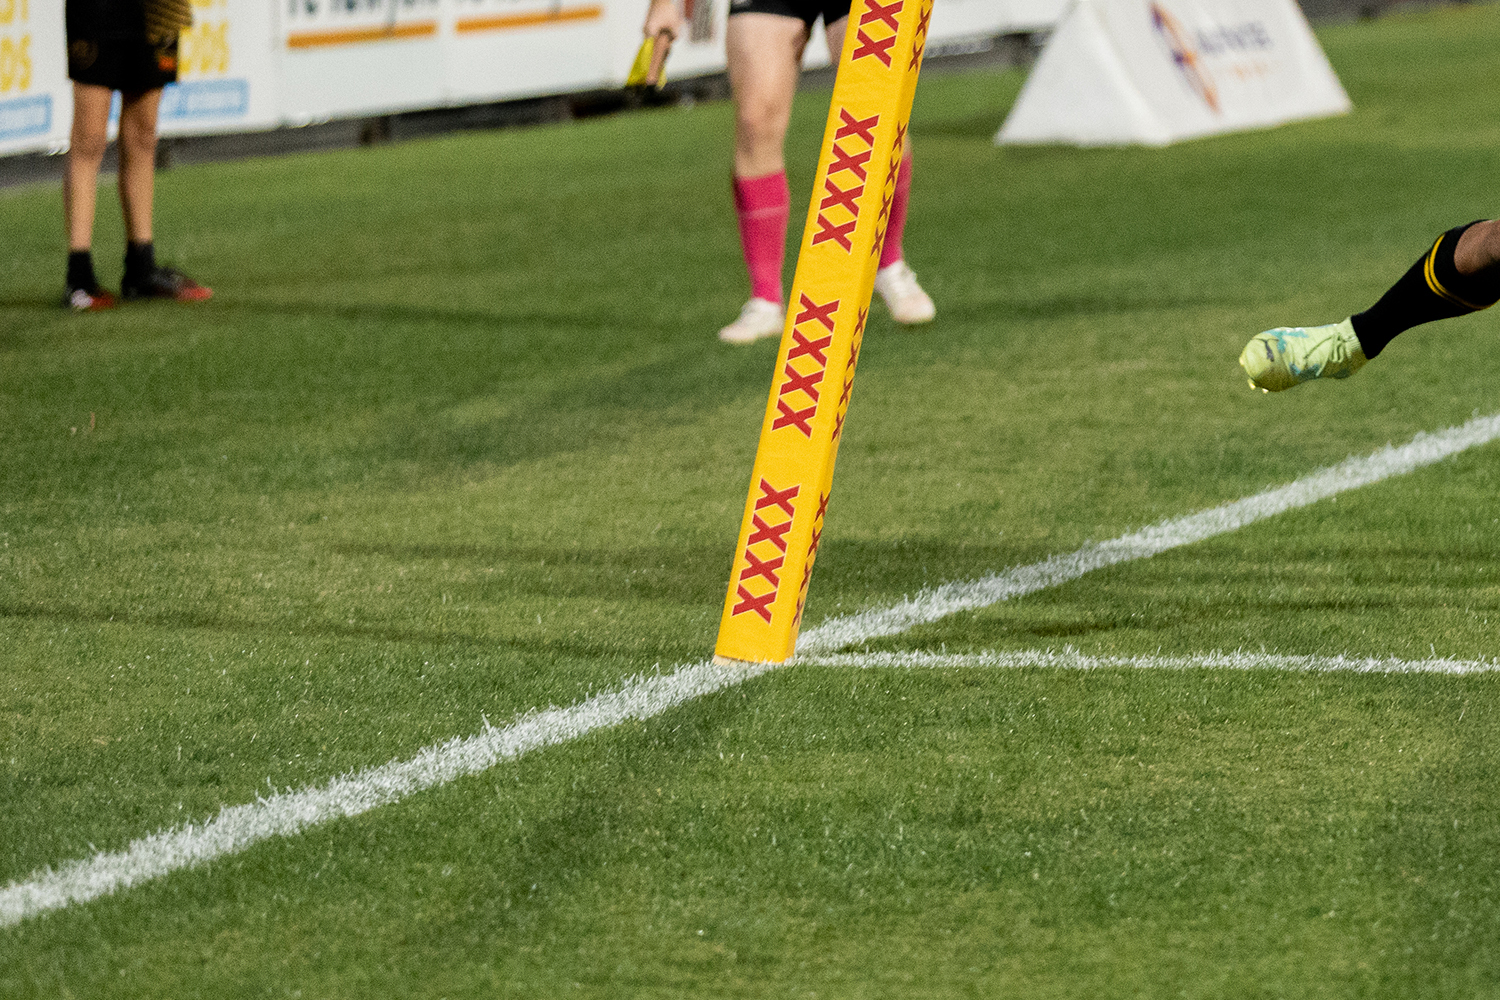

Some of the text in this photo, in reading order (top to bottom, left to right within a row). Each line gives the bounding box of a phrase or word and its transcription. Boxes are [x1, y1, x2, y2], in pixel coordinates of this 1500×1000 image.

[812, 107, 880, 254] XXXX
[772, 290, 840, 440] XXXX
[731, 476, 801, 626] XXXX
